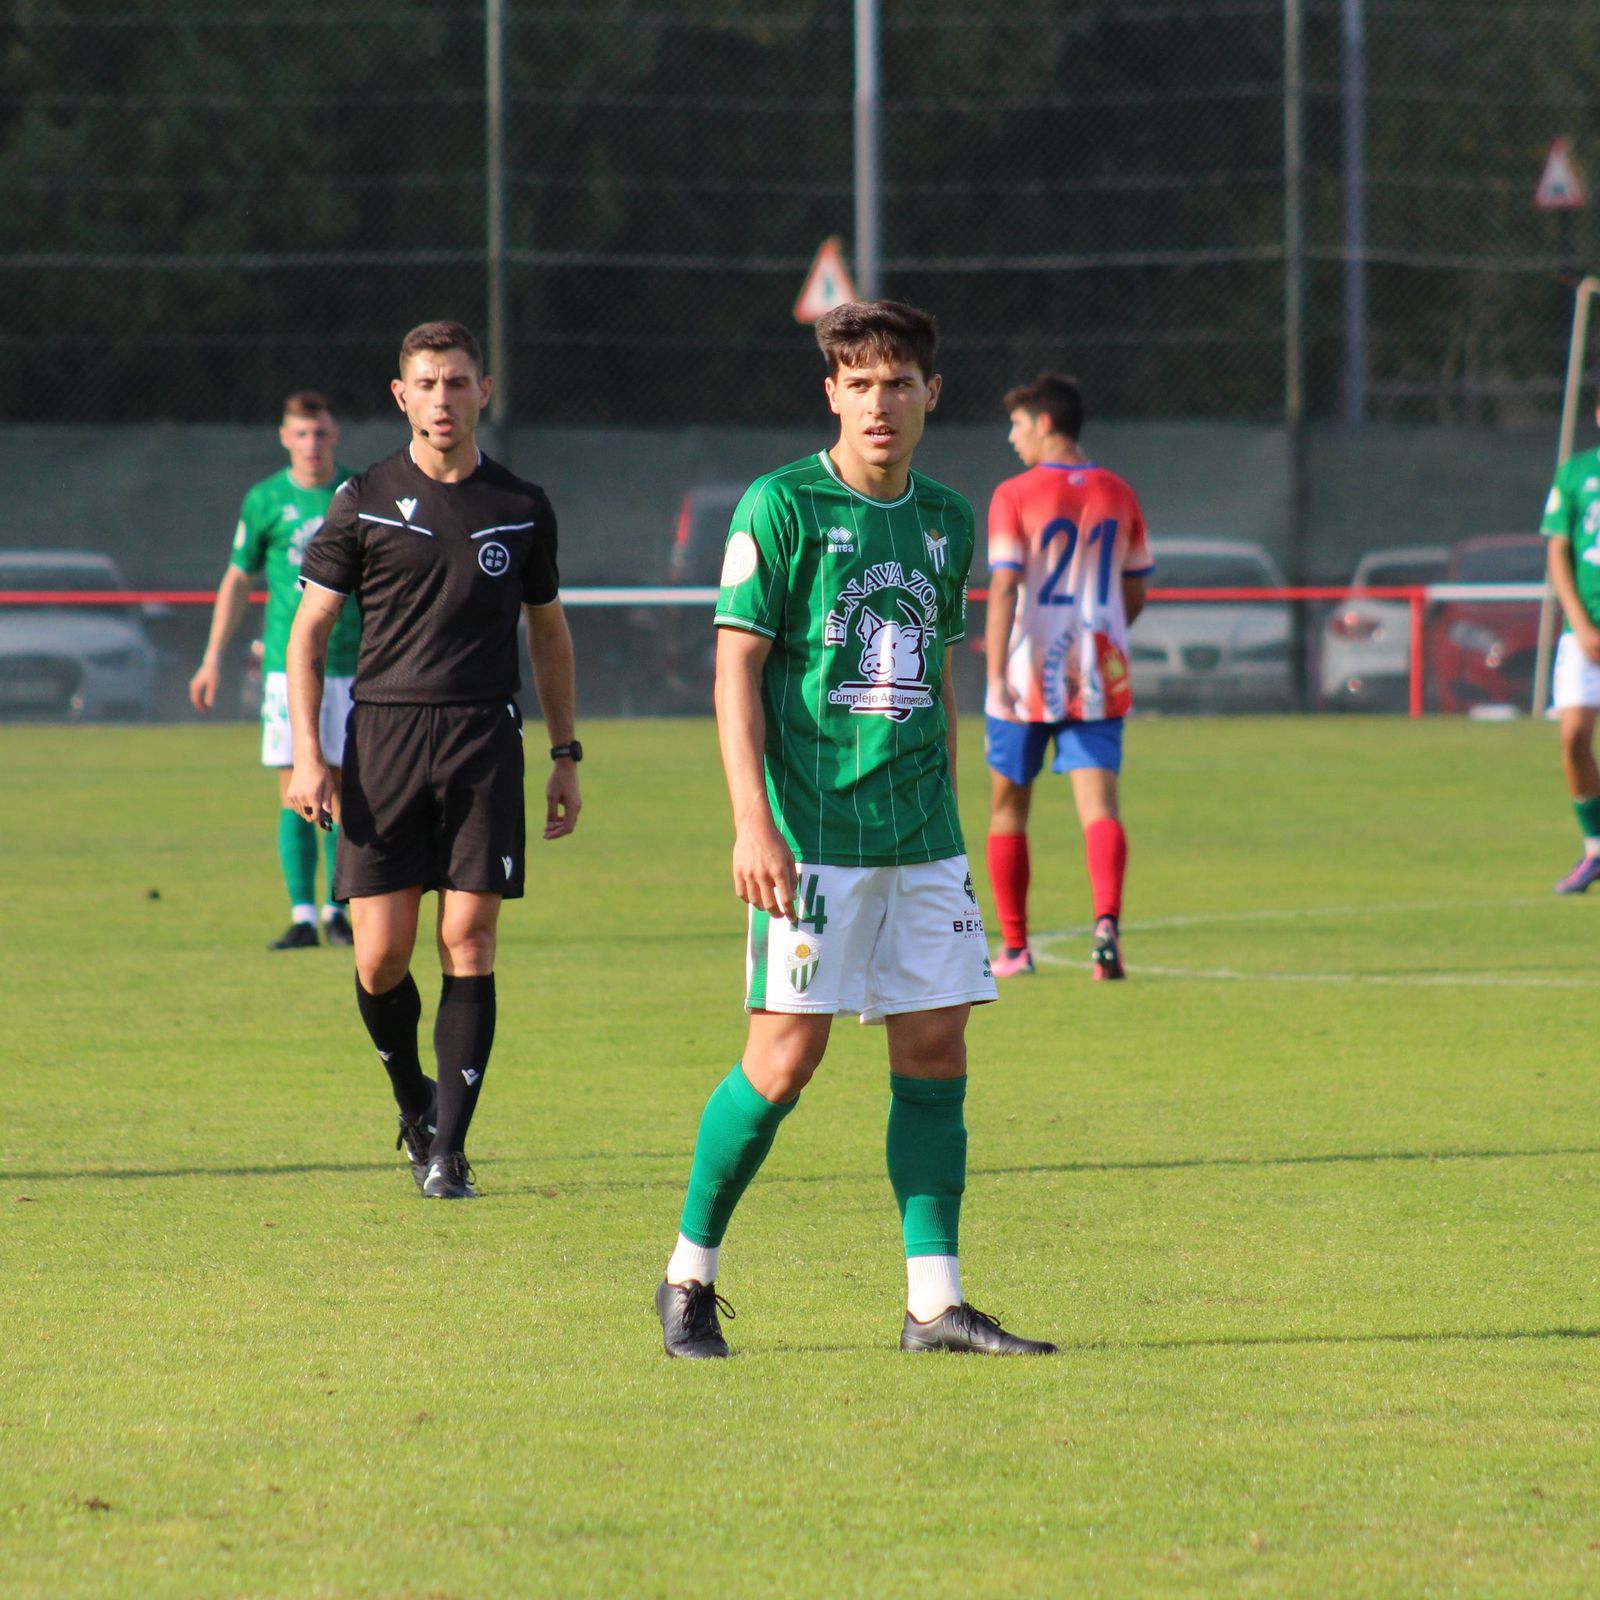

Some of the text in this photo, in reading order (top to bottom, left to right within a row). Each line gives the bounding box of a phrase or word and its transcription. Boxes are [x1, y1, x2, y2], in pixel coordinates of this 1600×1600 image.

[828, 543, 854, 553] errea
[1038, 517, 1118, 605] 21
[837, 562, 936, 609] NAVAZO
[825, 607, 850, 647] EL
[829, 692, 878, 704] Complejo
